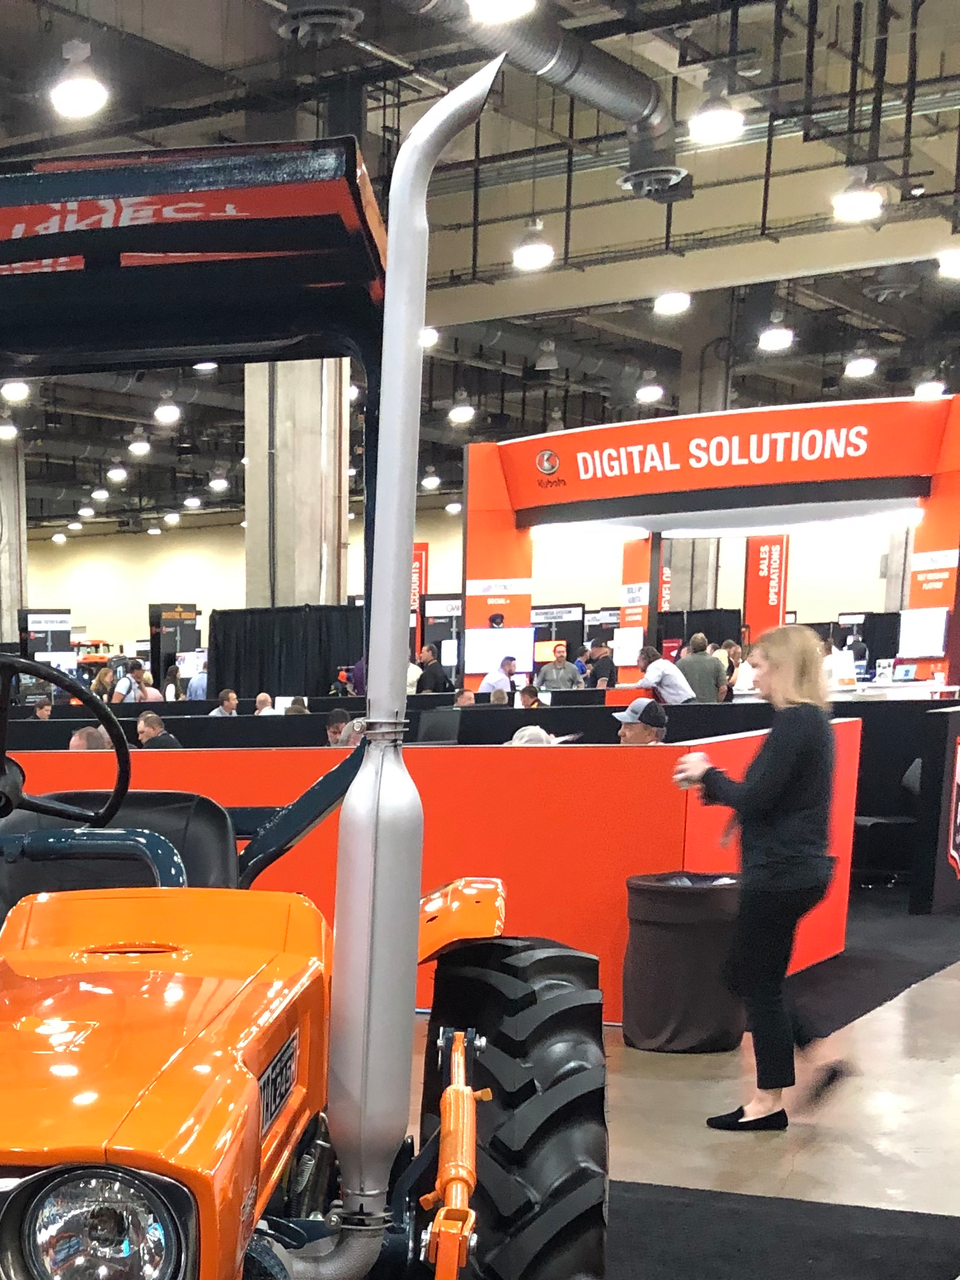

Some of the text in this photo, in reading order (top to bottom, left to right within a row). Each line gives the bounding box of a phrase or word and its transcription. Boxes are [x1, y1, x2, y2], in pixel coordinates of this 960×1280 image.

[576, 425, 868, 480] DIGITAL SOLUTIONS
[410, 561, 420, 612] ACCOUNTS
[759, 545, 769, 576] SALES
[769, 545, 780, 606] OPERATIONS
